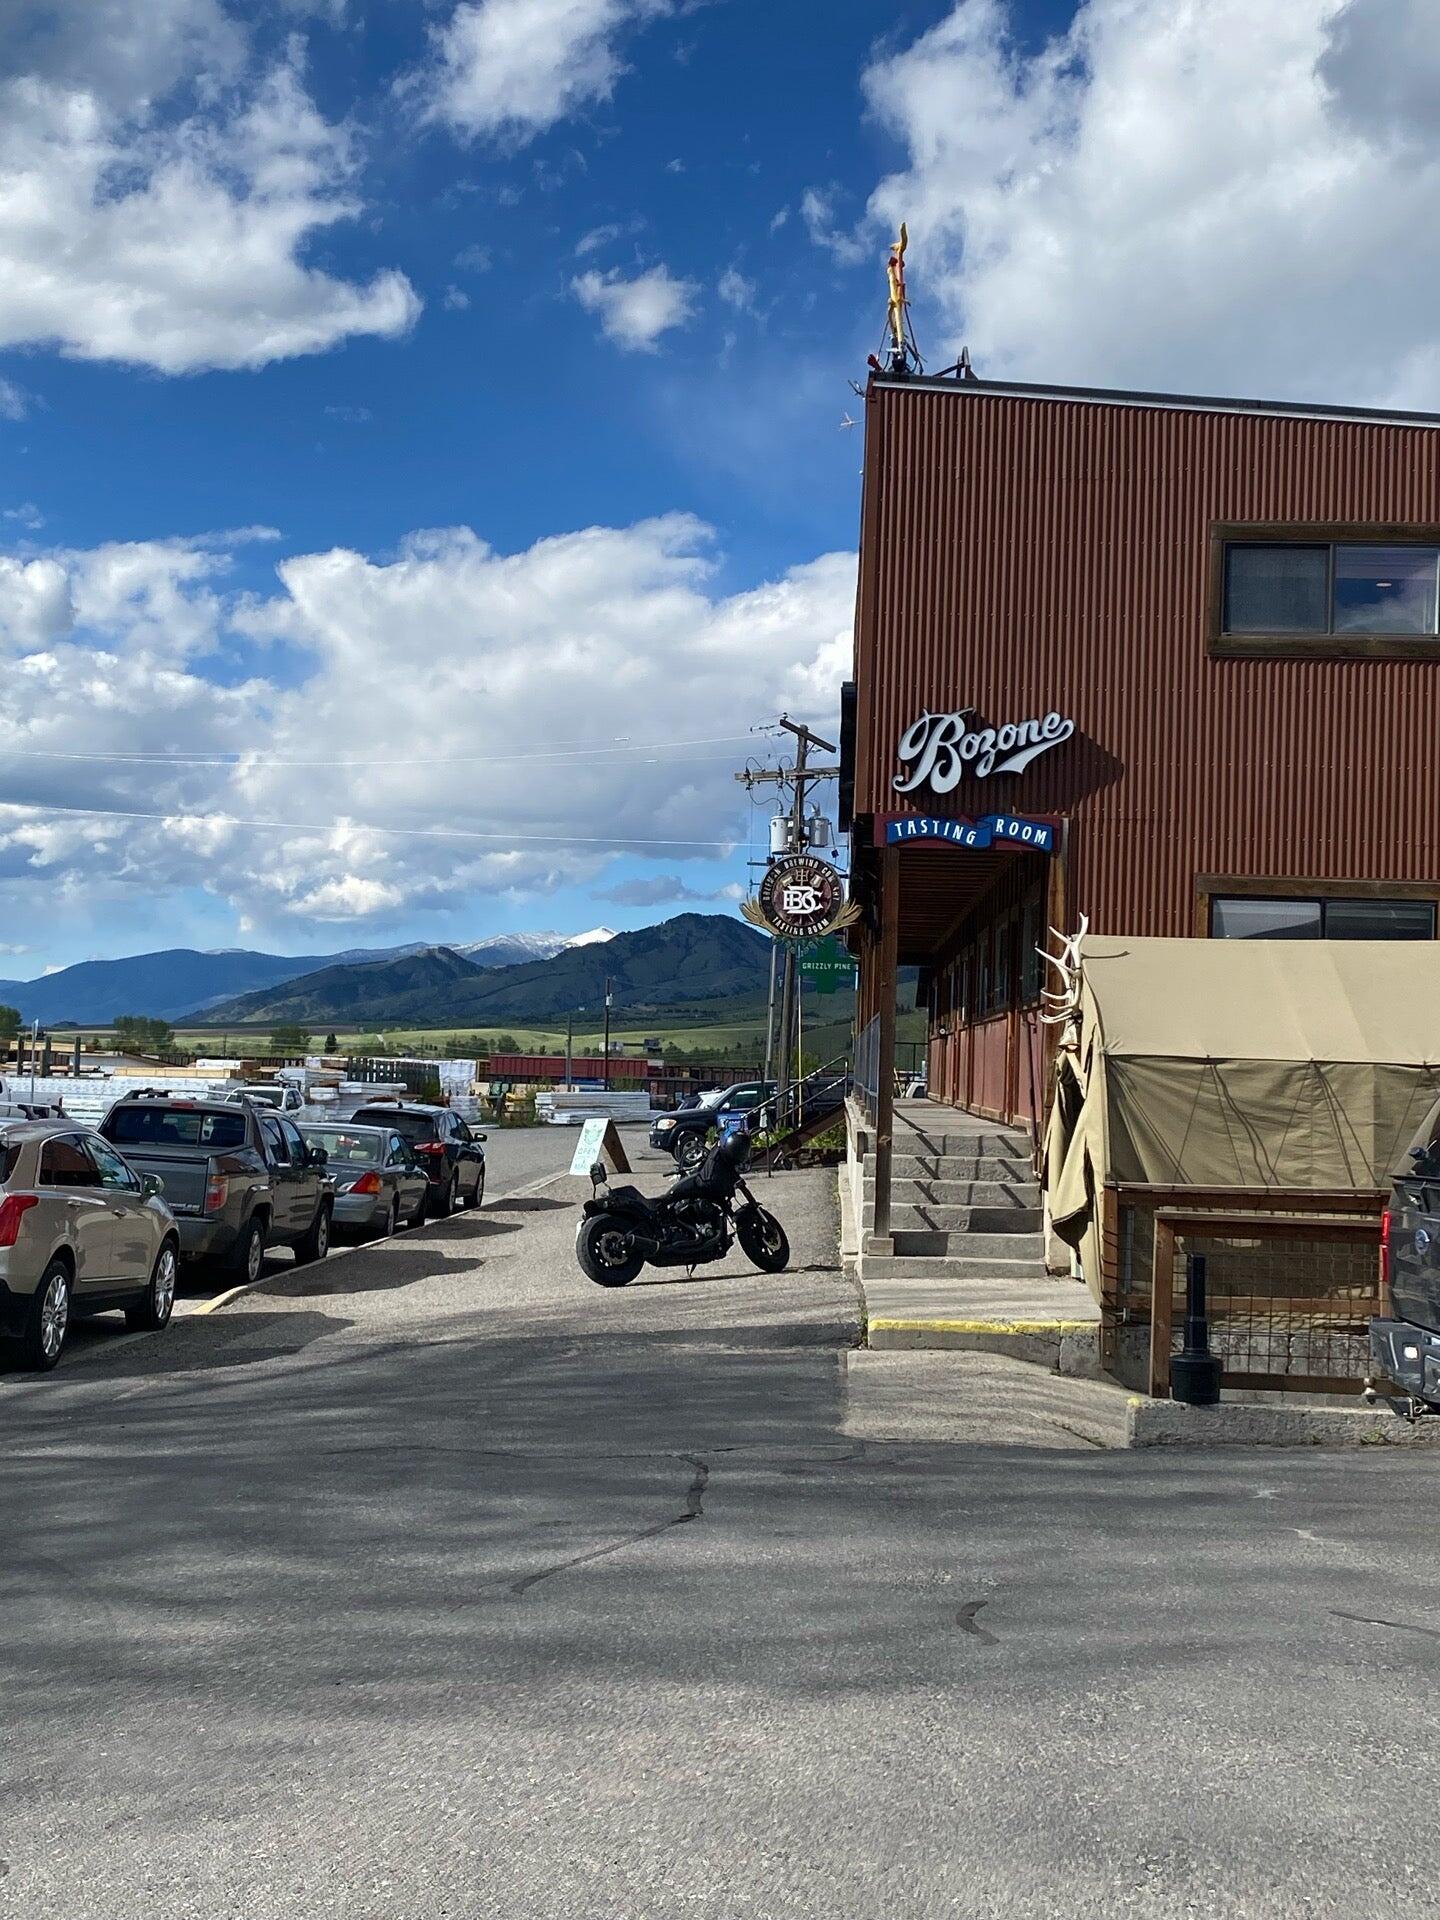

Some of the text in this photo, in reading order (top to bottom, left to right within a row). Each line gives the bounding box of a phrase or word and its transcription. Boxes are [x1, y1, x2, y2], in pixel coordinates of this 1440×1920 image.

[892, 707, 1075, 794] Bozone
[895, 818, 1048, 845] TASTING ROOM
[783, 857, 819, 869] BREWING
[772, 916, 830, 936] TASTING ROOM
[802, 962, 832, 970] GRIZZLY
